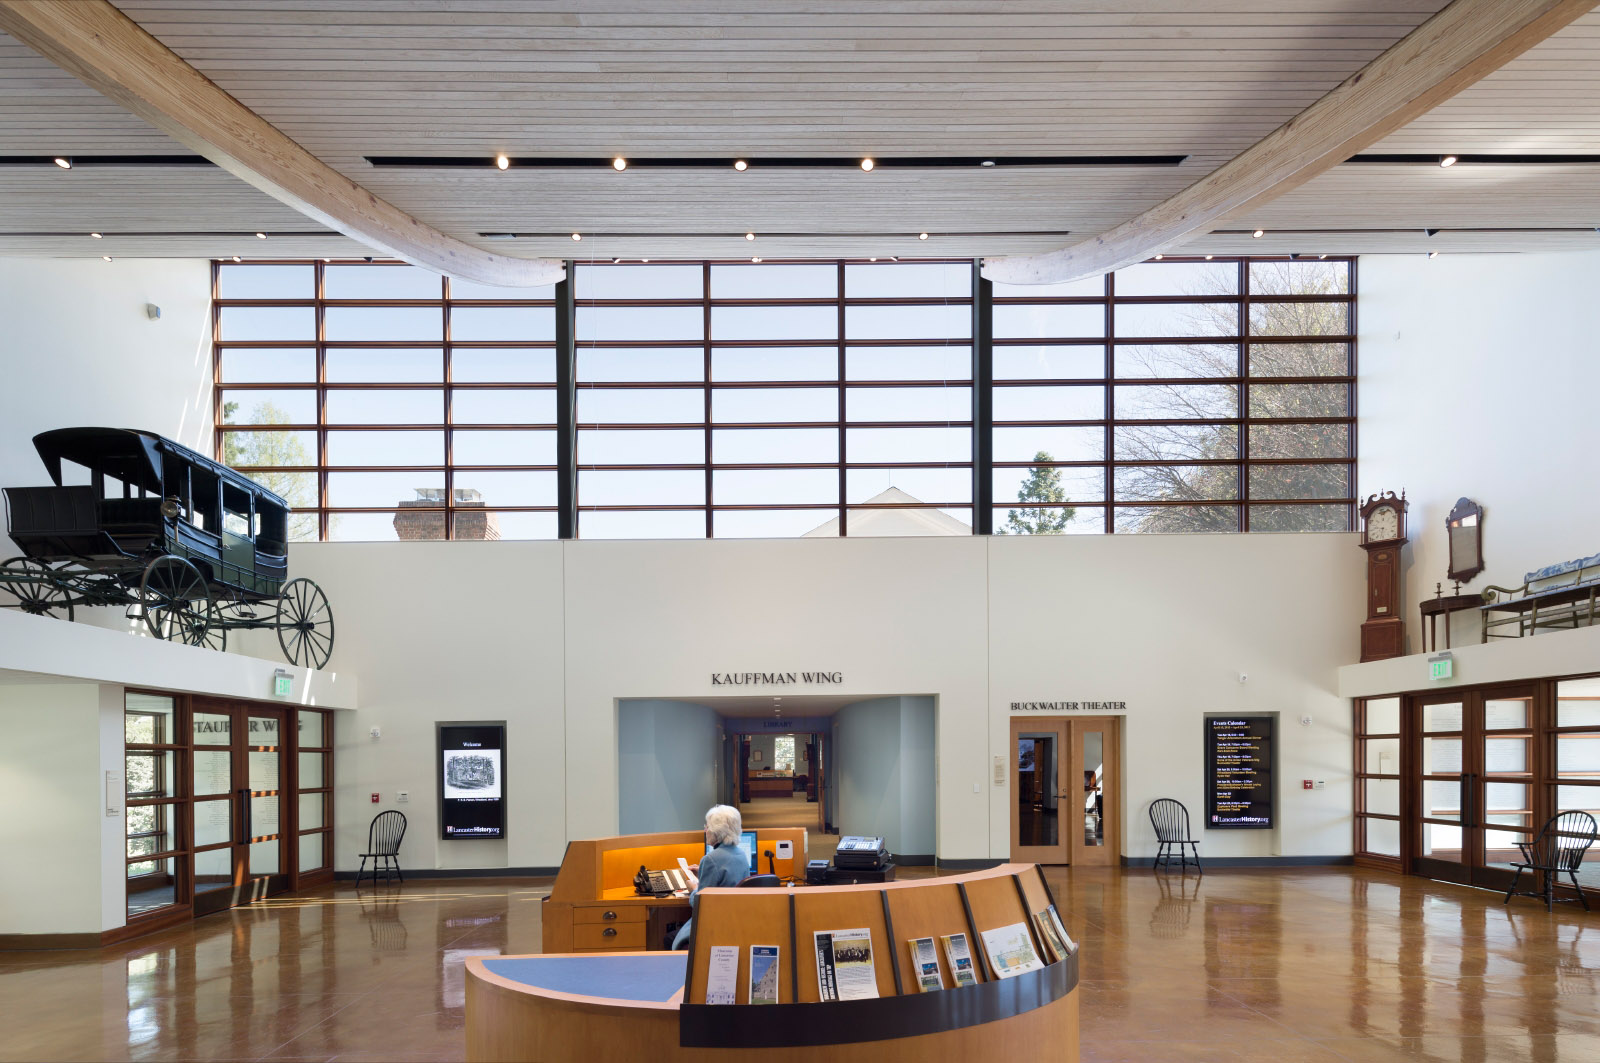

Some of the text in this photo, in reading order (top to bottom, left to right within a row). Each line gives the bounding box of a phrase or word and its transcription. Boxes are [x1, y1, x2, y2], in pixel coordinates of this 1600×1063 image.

[1433, 661, 1448, 676] EXIT
[712, 671, 842, 685] KAUFFMAN WING
[1010, 701, 1127, 711] BUCKWALTER THEATER
